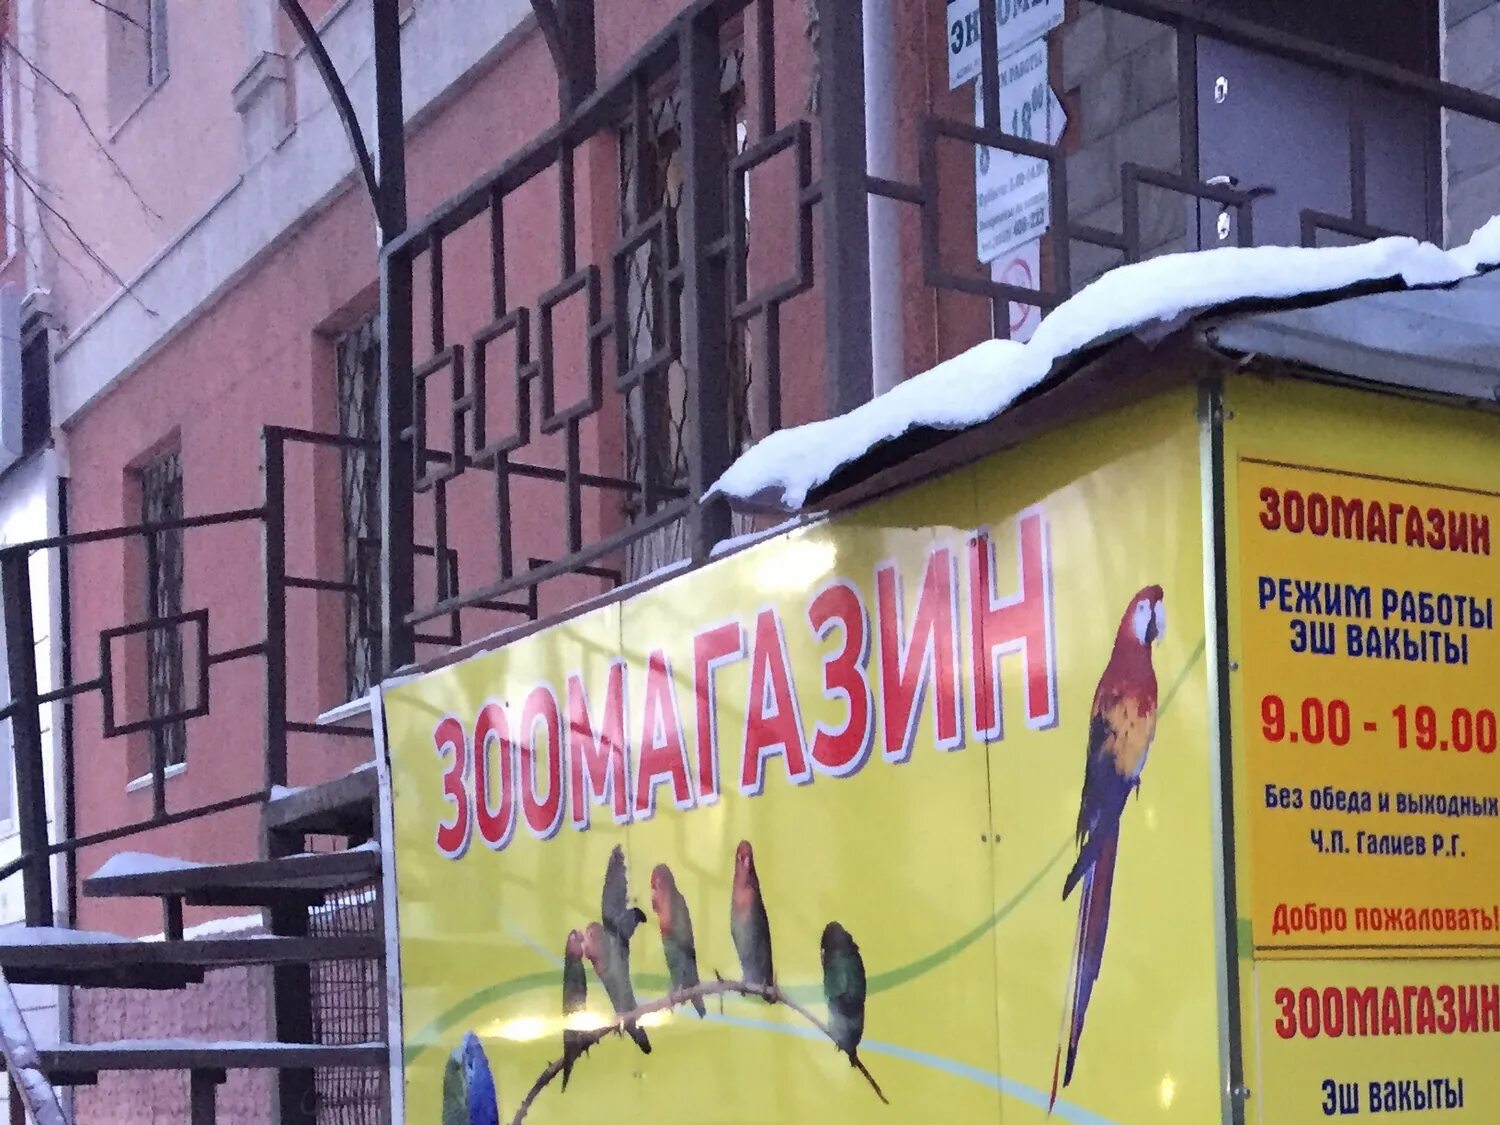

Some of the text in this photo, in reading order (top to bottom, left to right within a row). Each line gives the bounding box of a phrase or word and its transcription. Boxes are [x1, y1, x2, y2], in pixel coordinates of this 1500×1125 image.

[1259, 487, 1491, 556] ЗООМАГАЗИН
[1258, 575, 1493, 630] РЕЖИМ РАБОТЫ
[1289, 618, 1469, 666] ЭШ ВАКЫТЫ
[433, 505, 1058, 859] ЗООМАГАЗИН
[1261, 694, 1351, 746] 9.00
[1392, 704, 1498, 754] 19.00
[1265, 783, 1499, 817] Без обеда и выходных
[1310, 829, 1466, 858] Ч.П. Галиев Р.Г.
[1272, 903, 1500, 935] Добро пожаловать!
[1274, 983, 1500, 1040] ЗООМАГАЗИН
[1321, 1077, 1464, 1116] Эш вакыты
